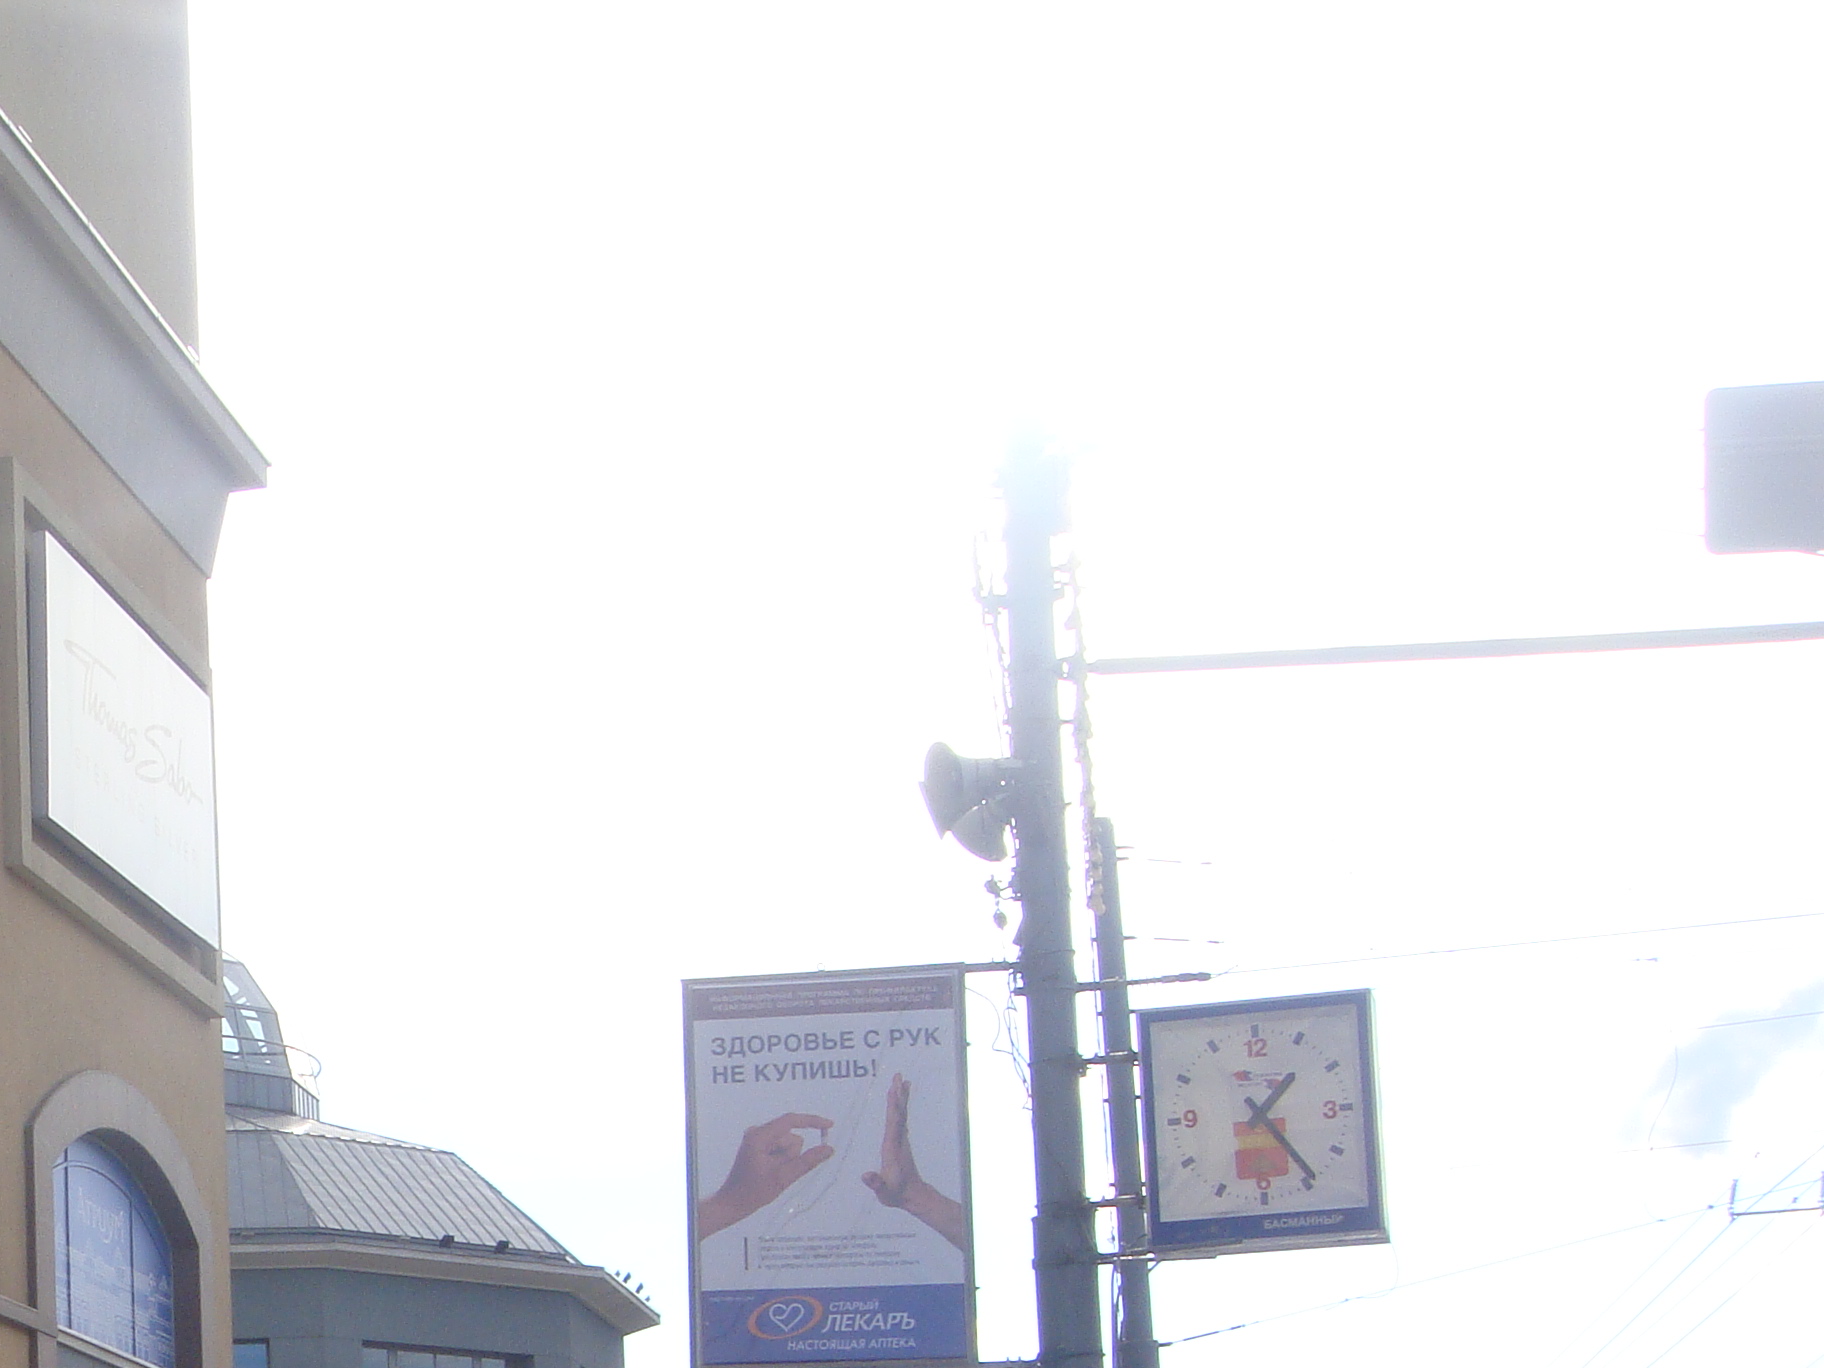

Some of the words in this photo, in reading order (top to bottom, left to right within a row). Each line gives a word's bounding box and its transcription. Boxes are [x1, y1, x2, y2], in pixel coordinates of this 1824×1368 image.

[711, 1031, 855, 1058] ЗДОРОВЬЕ
[863, 1030, 880, 1049] С
[889, 1027, 941, 1048] РУК
[1243, 1038, 1268, 1058] 12
[712, 1065, 746, 1084] НЕ
[755, 1059, 877, 1082] КУПИШЬ!
[1183, 1109, 1198, 1128] 9
[1323, 1101, 1338, 1119] 3
[829, 1299, 879, 1312] СТАРЫЙ
[821, 1312, 915, 1333] ЛЕКАРЪ
[787, 1338, 866, 1351] НАСТОЯЩАЯ
[868, 1337, 916, 1349] АПТЕКА
